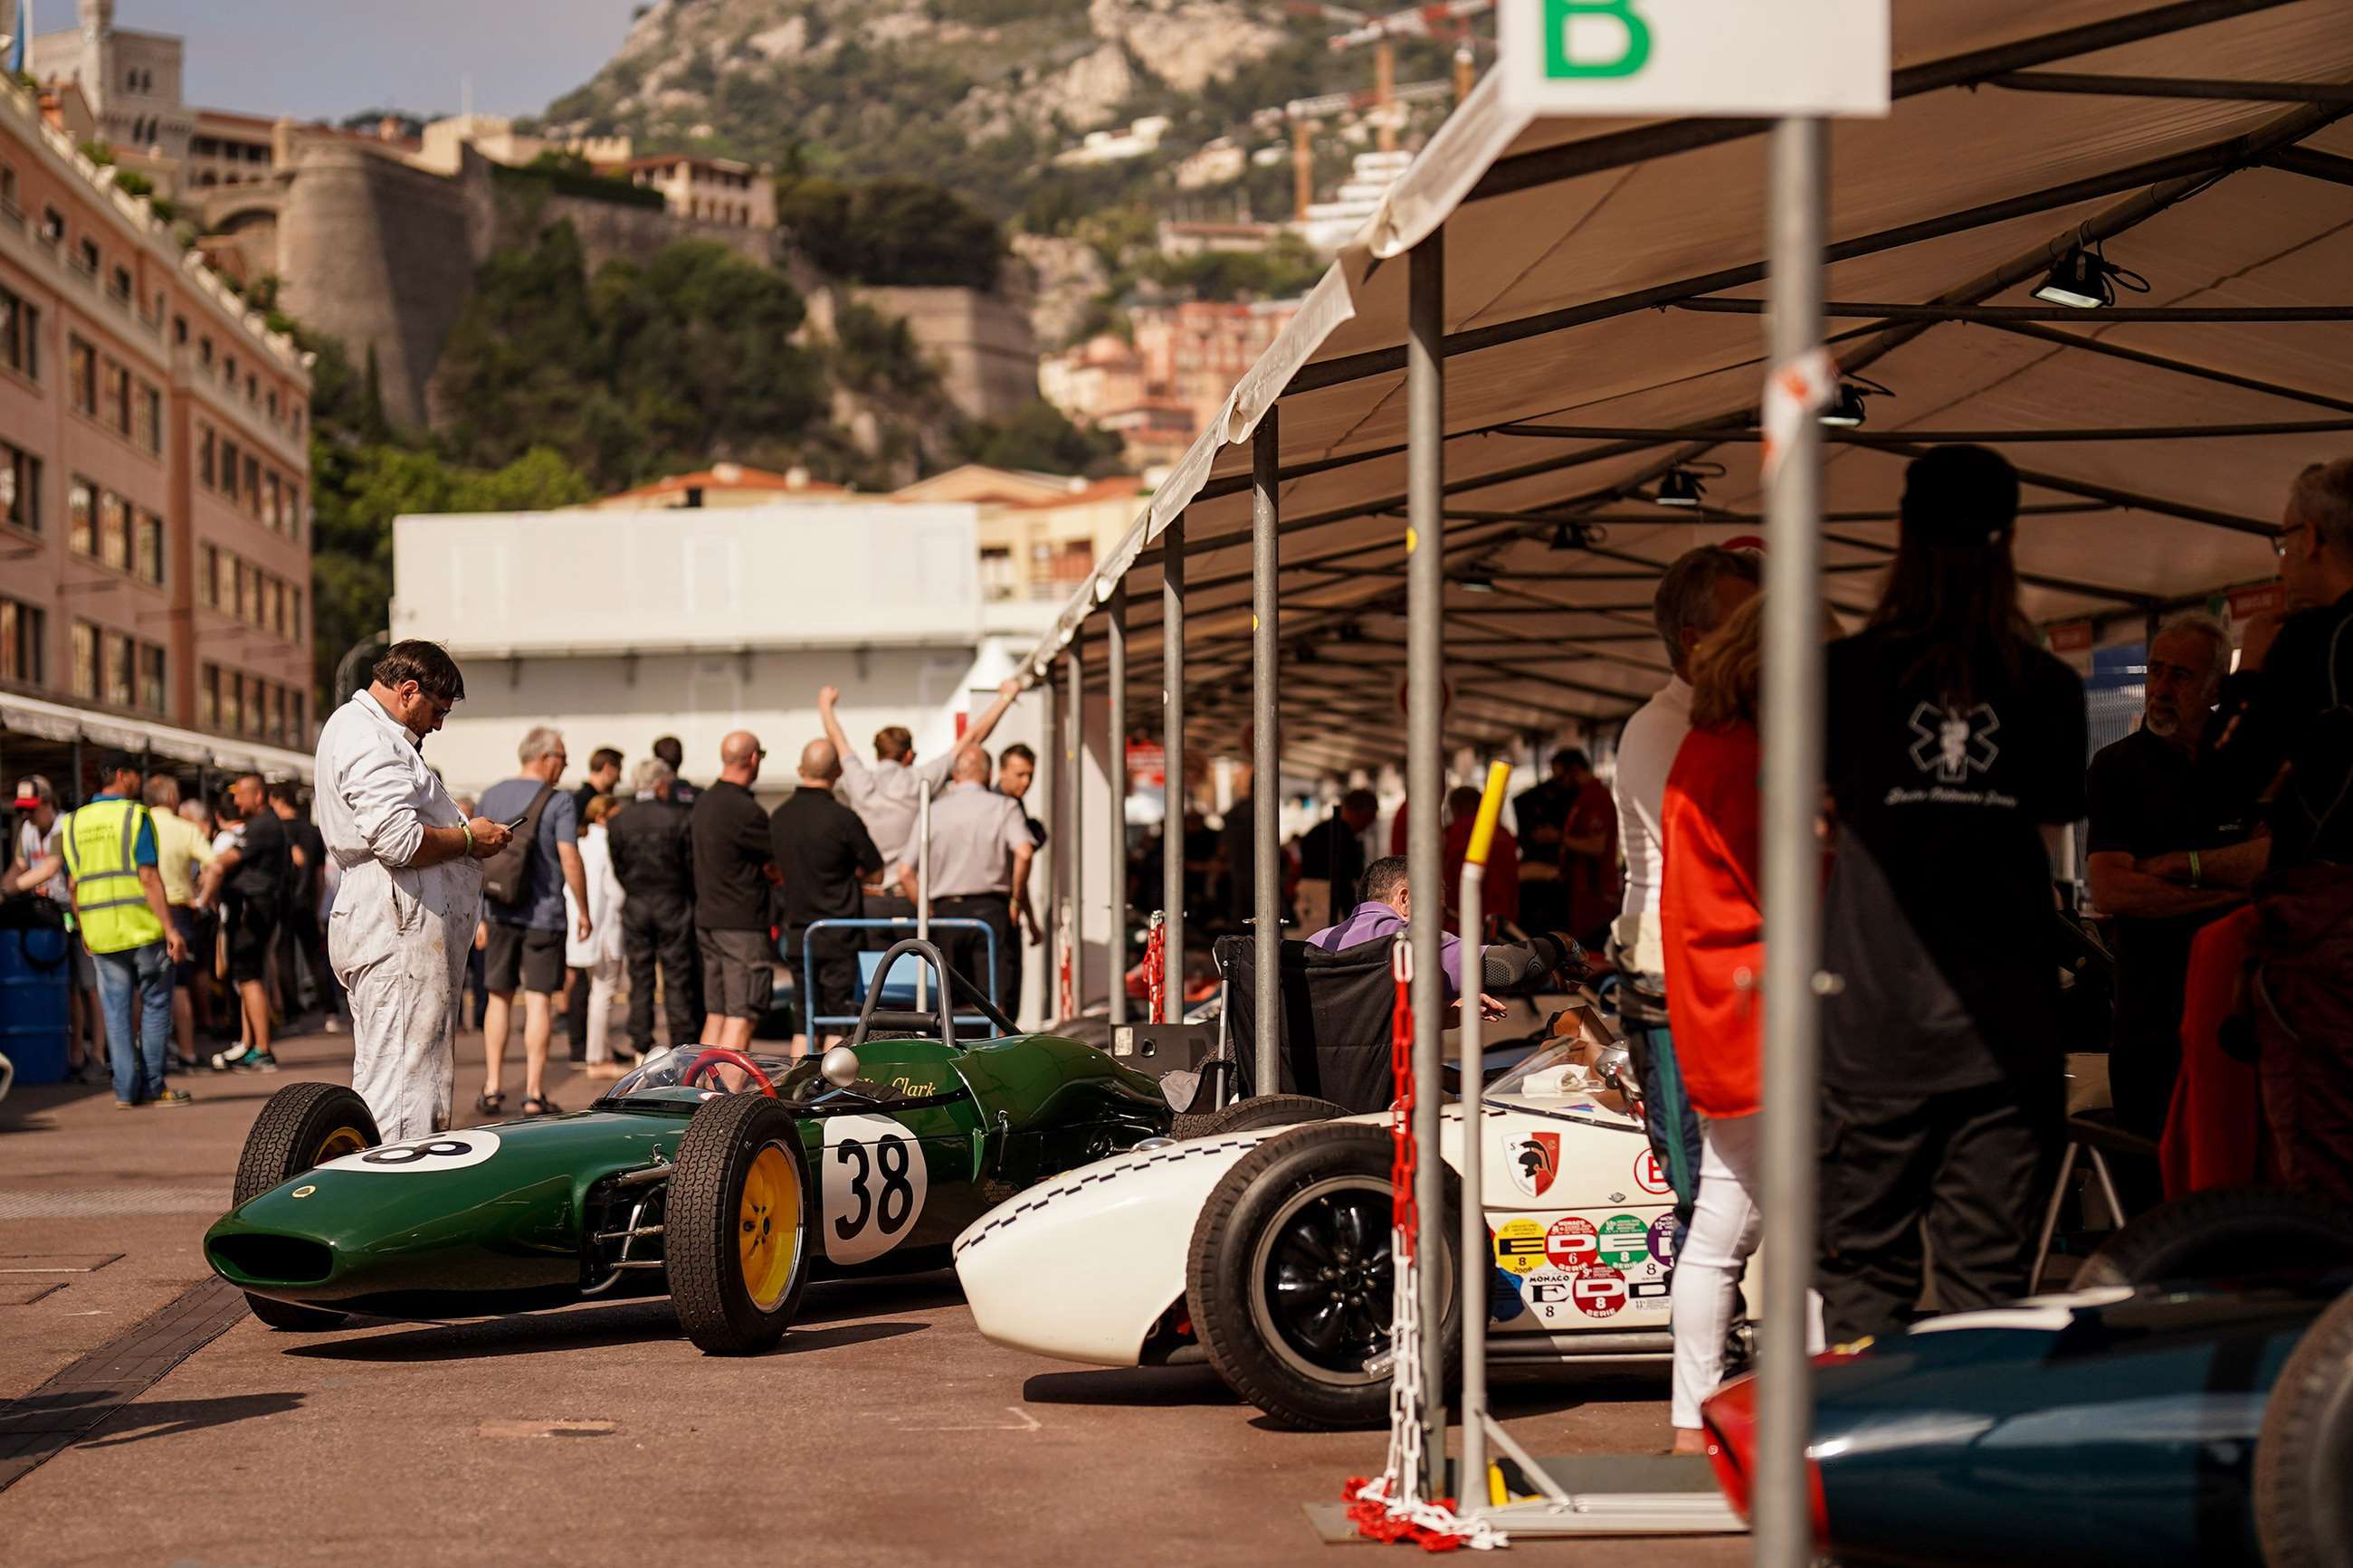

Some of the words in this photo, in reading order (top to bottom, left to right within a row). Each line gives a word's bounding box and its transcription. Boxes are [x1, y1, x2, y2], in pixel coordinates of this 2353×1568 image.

[1544, 0, 1653, 78] B
[891, 1077, 936, 1097] Clark
[834, 1134, 913, 1240] 38
[1519, 1257, 1527, 1267] 8
[1568, 1253, 1577, 1264] 6
[1647, 1263, 1656, 1275] 8
[1529, 1275, 1569, 1283] MONACO
[1530, 1284, 1570, 1303] E
[1596, 1297, 1606, 1309] 8
[1546, 1306, 1554, 1317] 8
